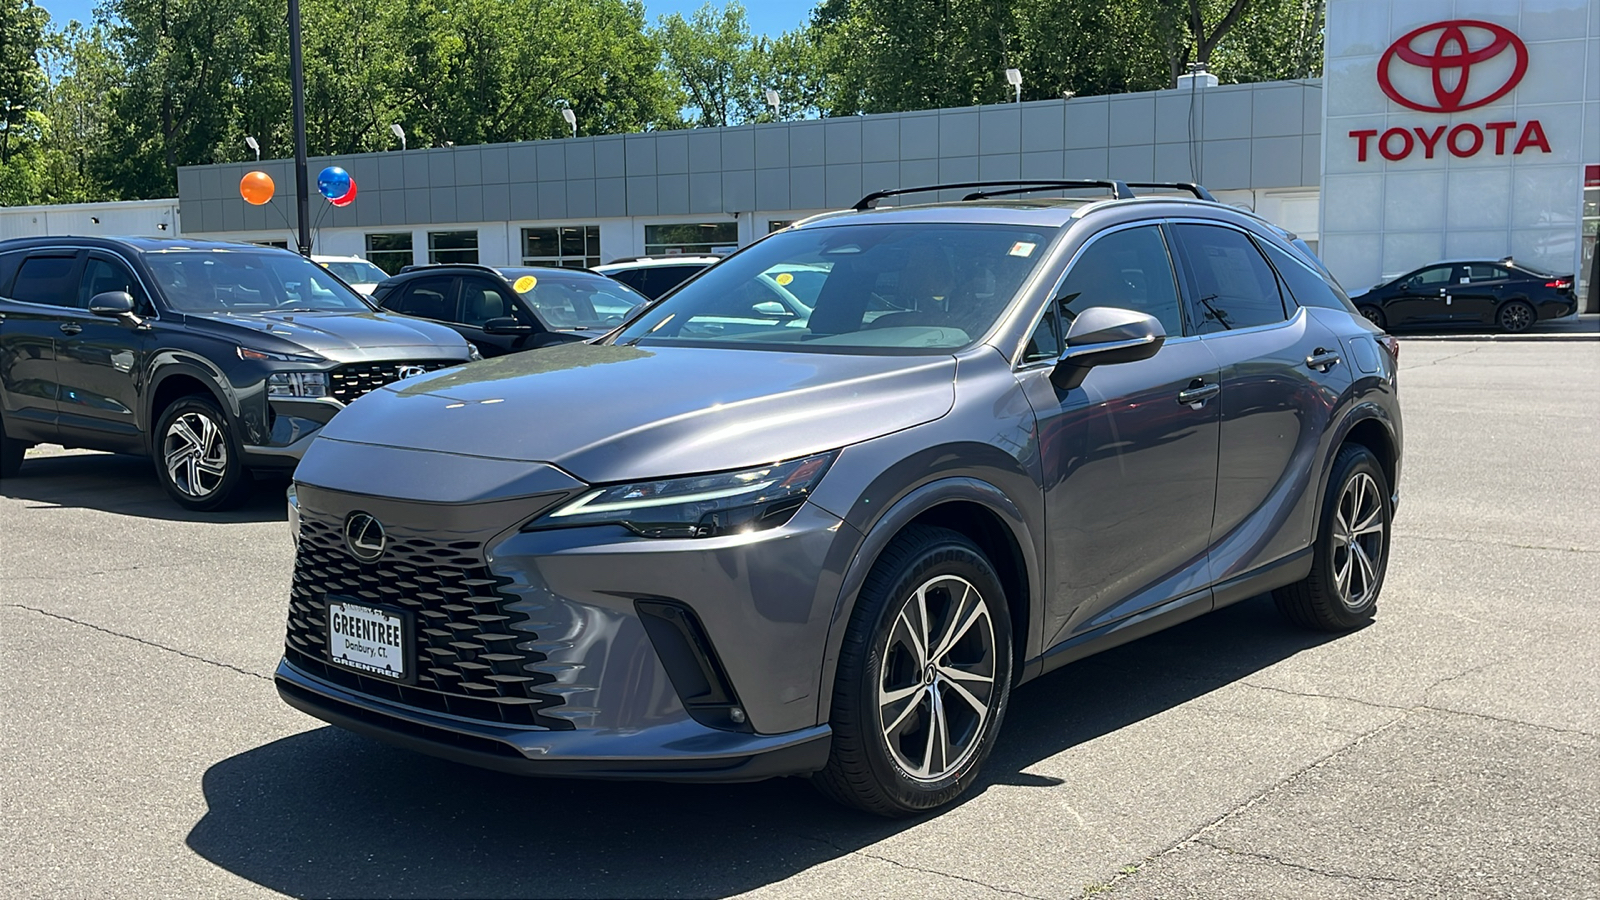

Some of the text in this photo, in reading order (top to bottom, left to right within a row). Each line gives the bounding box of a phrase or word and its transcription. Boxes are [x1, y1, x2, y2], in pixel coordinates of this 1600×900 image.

[1349, 120, 1552, 162] TOYOTA
[333, 612, 400, 647] GREENTREE
[345, 638, 388, 659] Danbury, CT.
[332, 656, 400, 679] GREENTREE
